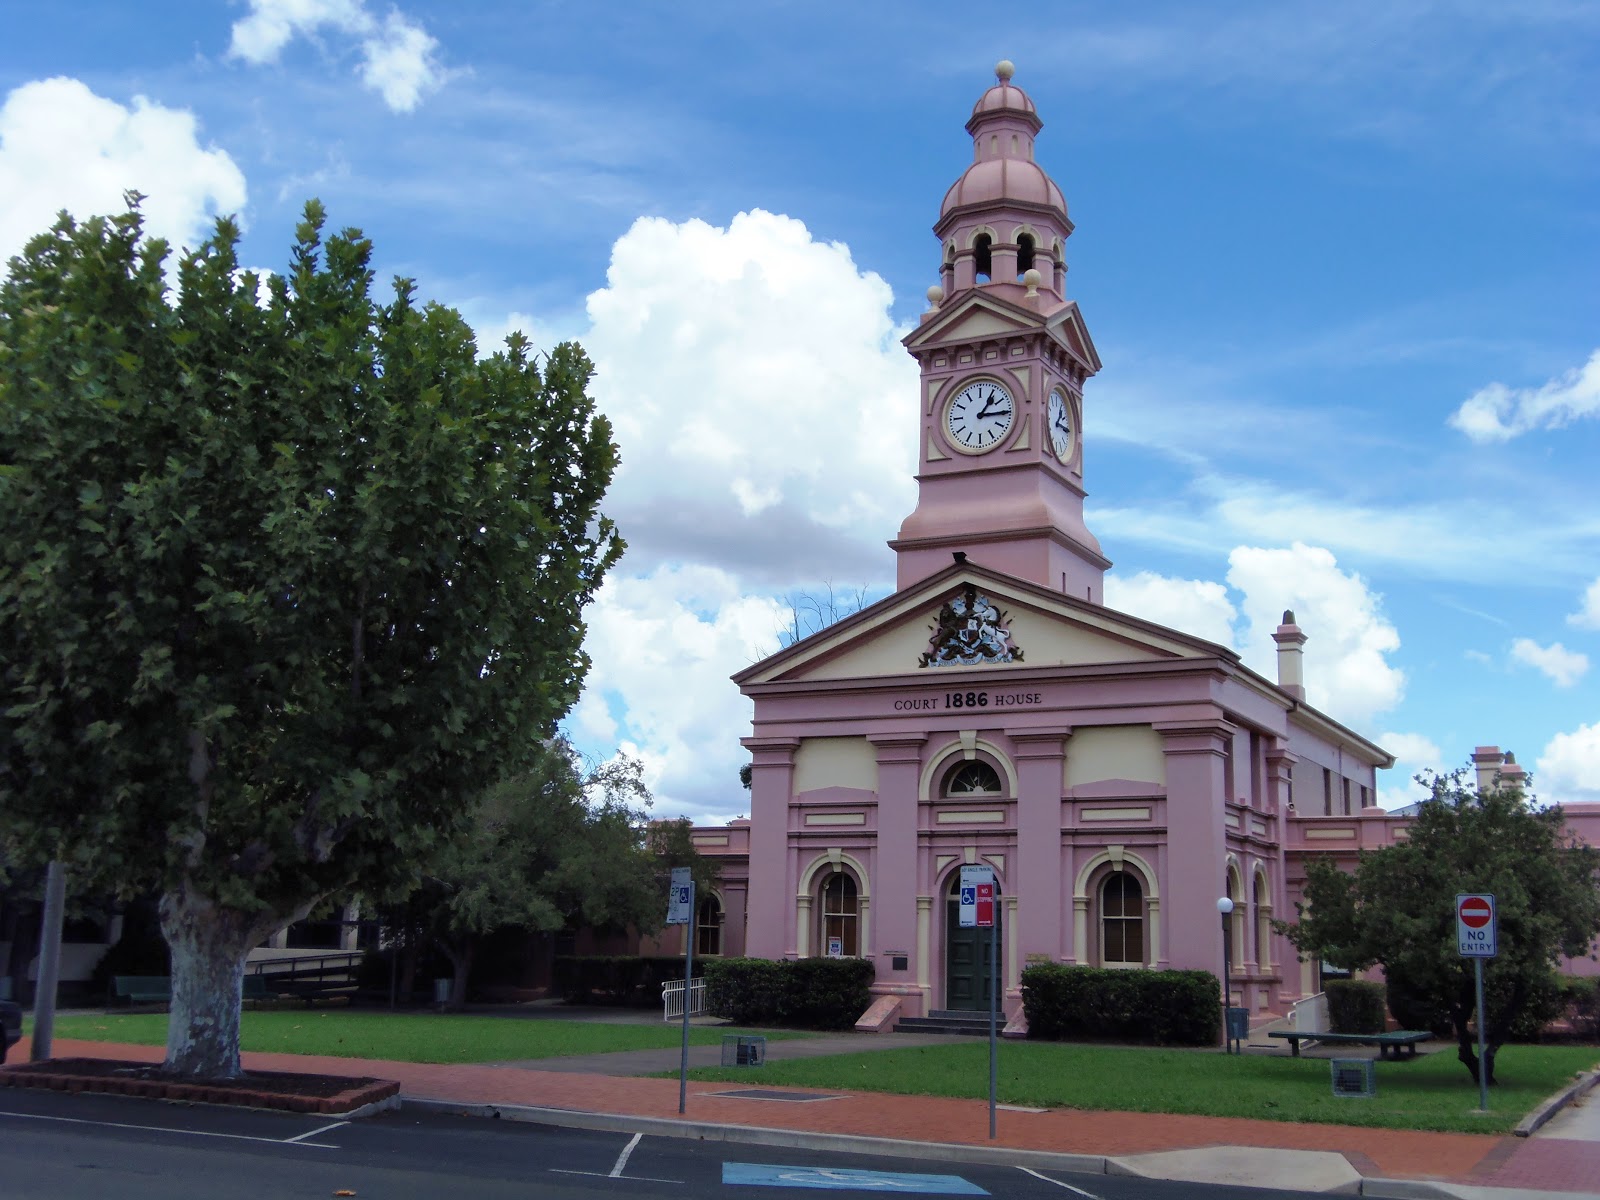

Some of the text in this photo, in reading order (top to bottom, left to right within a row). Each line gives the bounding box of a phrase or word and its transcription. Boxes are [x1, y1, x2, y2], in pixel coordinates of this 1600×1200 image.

[894, 692, 1042, 711] COURT 1886 HOUSE
[1467, 931, 1485, 941] NO
[1461, 943, 1492, 952] ENTRY
